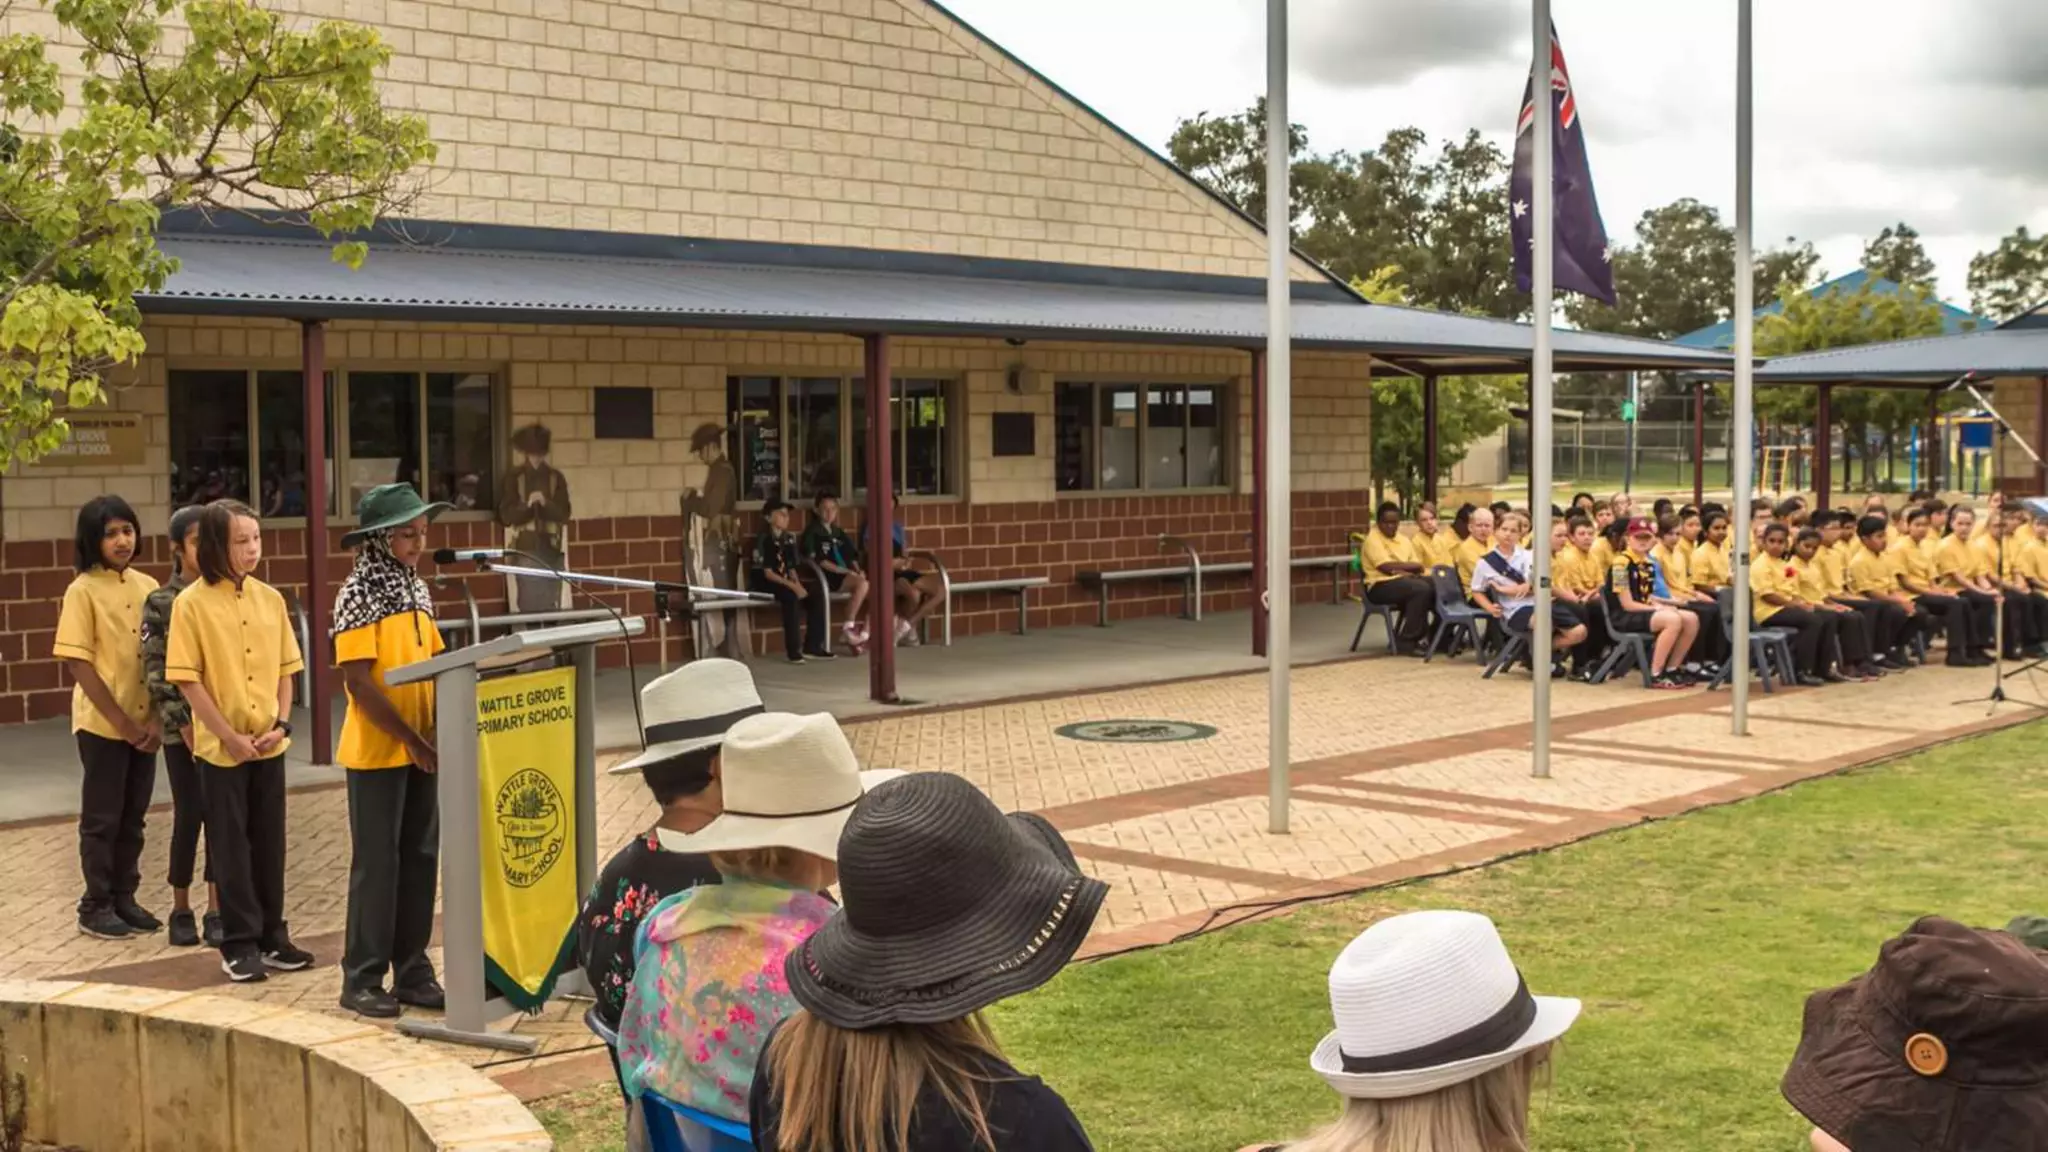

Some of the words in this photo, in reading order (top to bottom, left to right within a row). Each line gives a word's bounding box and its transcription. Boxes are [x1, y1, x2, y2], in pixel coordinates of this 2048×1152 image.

[480, 692, 525, 715] WATTLE
[526, 686, 566, 706] GROVE
[477, 713, 526, 736] PRIMARY
[527, 704, 573, 726] SCHOOL
[495, 774, 526, 813] WATTLE
[528, 772, 557, 801] GROVE
